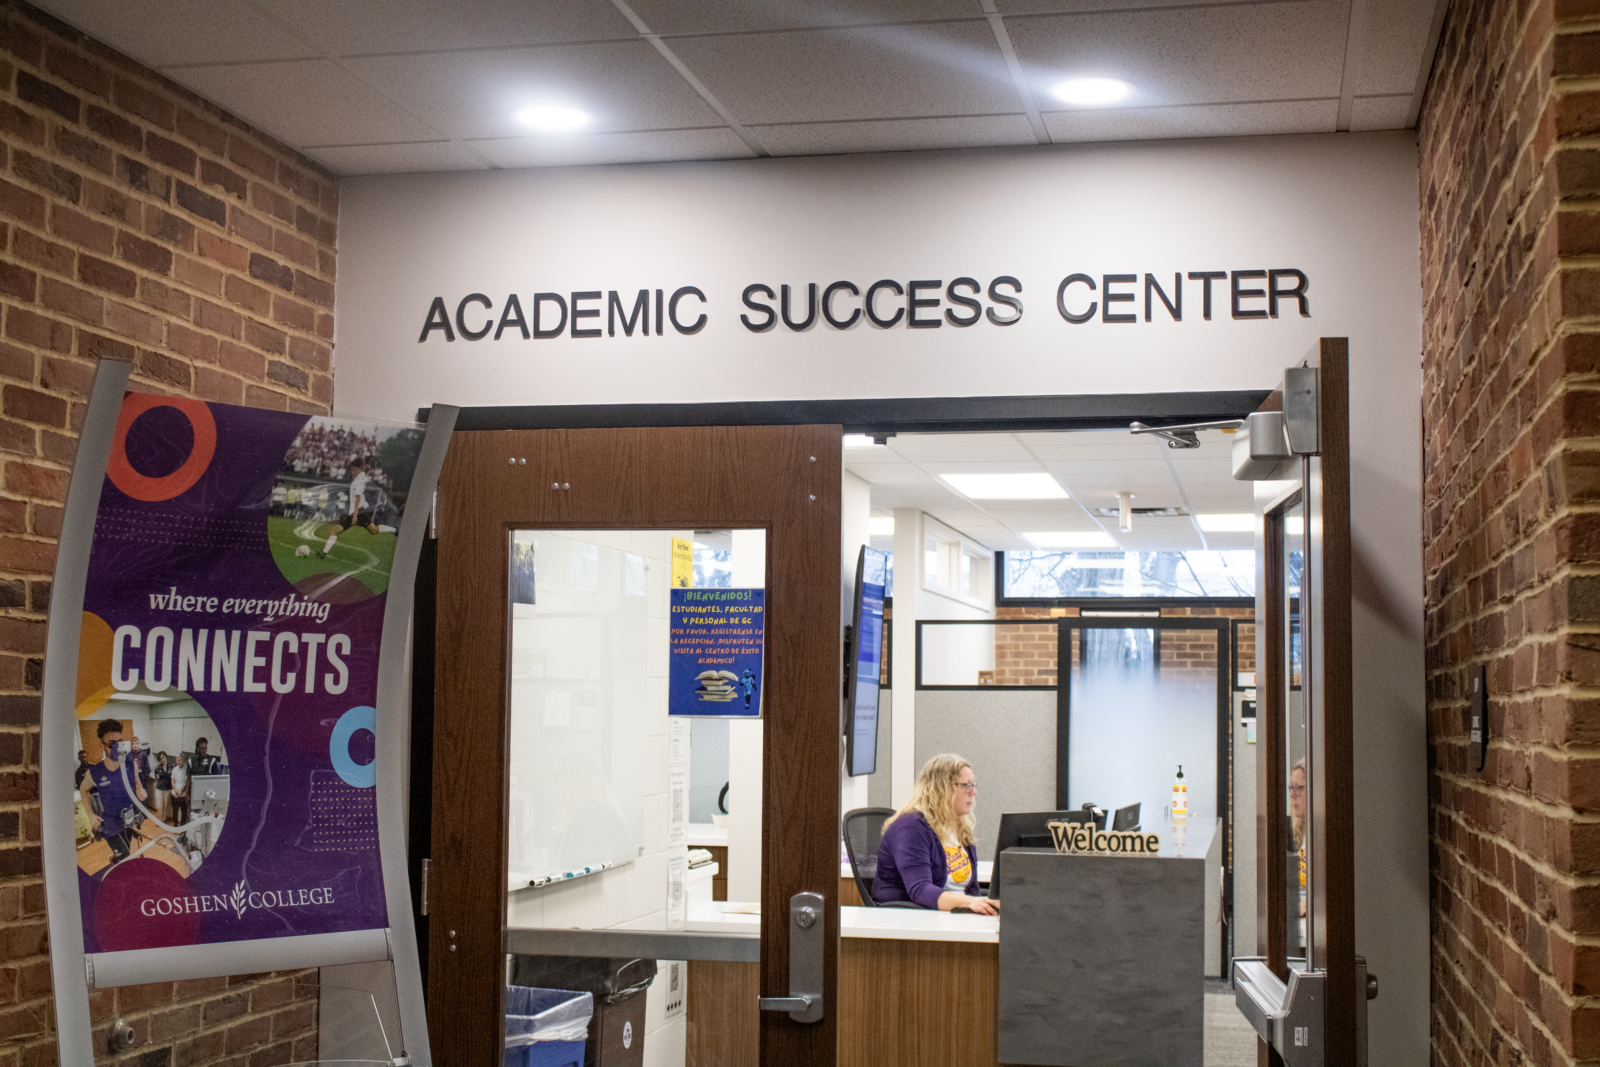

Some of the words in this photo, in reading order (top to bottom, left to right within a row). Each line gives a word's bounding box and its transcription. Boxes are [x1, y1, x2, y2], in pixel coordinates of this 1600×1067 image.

[418, 286, 707, 342] ACADEMIC
[739, 276, 1023, 333] SUCCESS
[1056, 269, 1312, 323] CENTER
[149, 586, 219, 614] where
[222, 594, 331, 624] everything
[671, 605, 723, 614] ESTUDIANTES,
[724, 606, 763, 614] FACULTAD
[689, 617, 728, 625] PERSONAL
[111, 624, 351, 695] CONNECTS
[1050, 825, 1159, 853] Welcome
[141, 894, 229, 917] GOSHEN
[248, 887, 335, 910] COLLEGE
